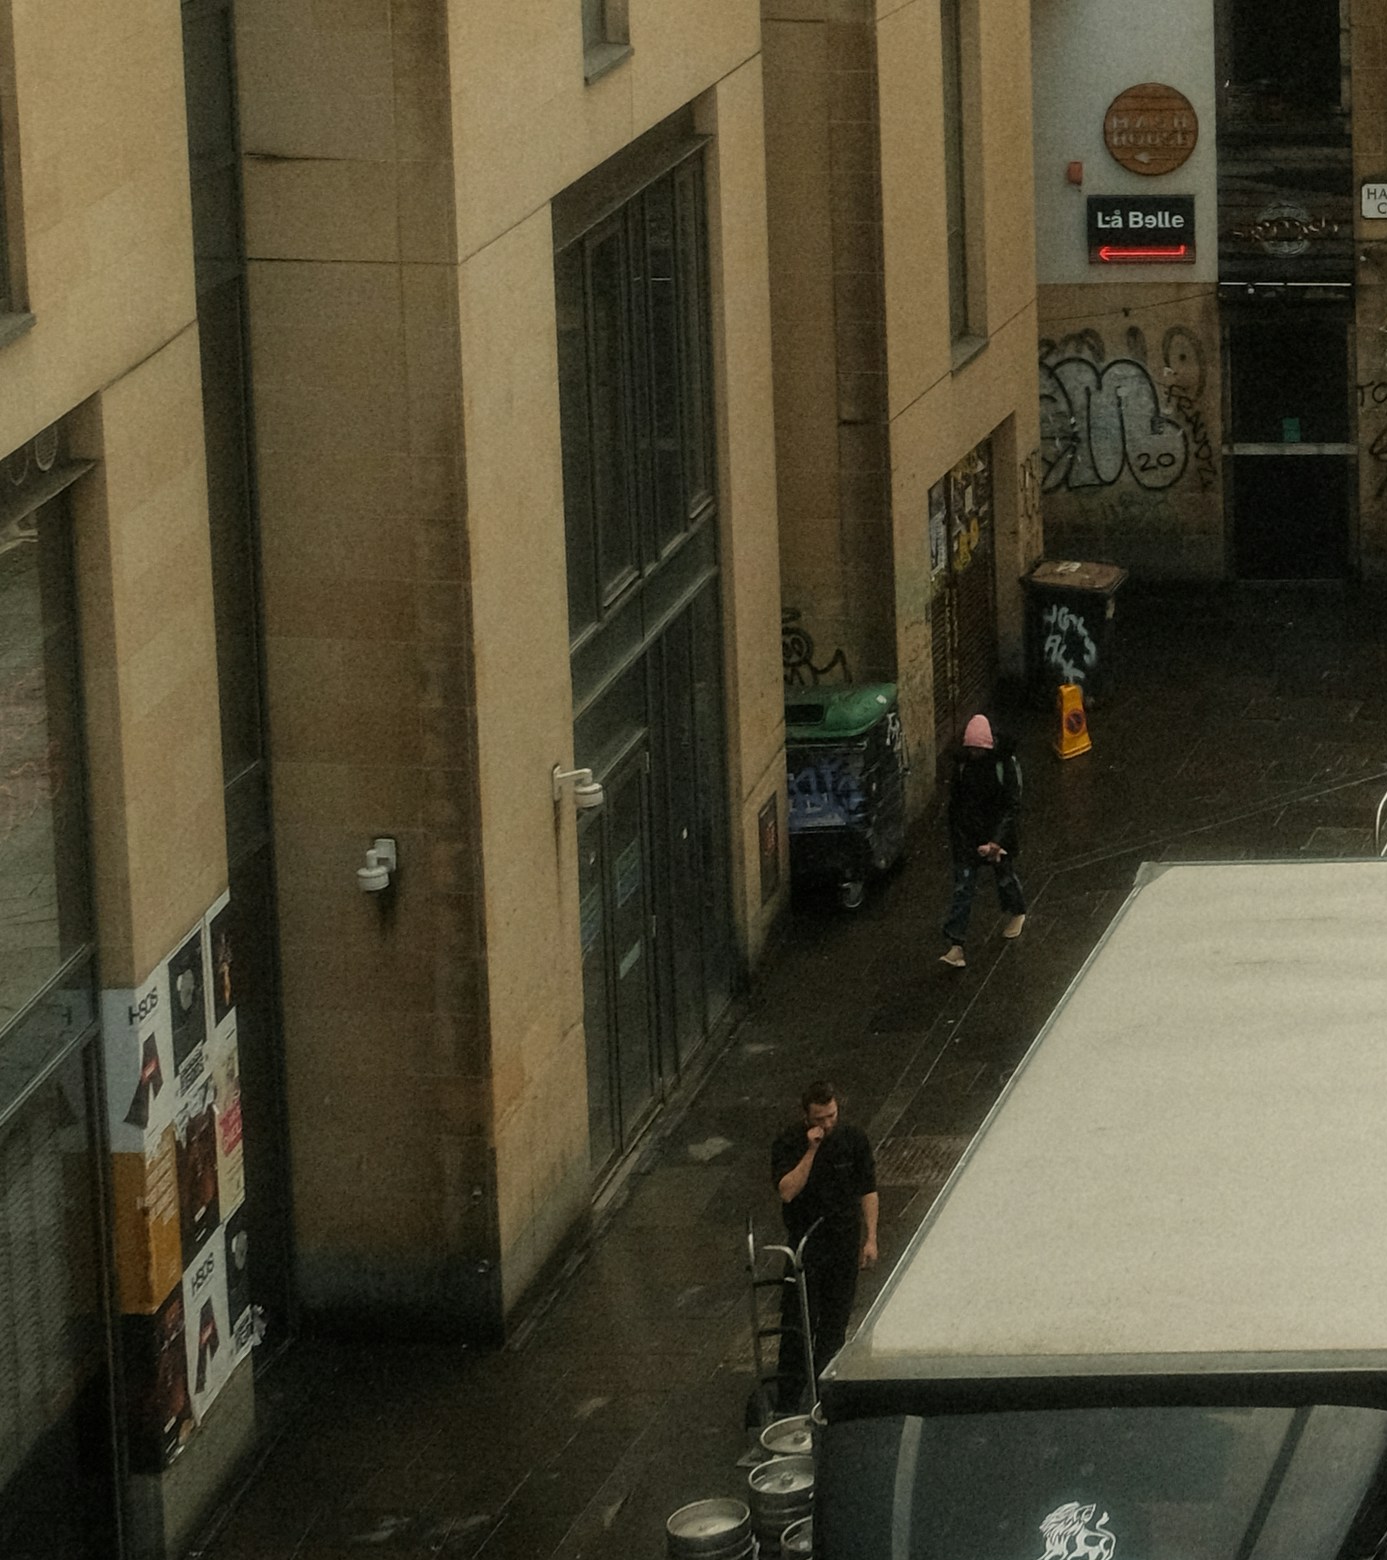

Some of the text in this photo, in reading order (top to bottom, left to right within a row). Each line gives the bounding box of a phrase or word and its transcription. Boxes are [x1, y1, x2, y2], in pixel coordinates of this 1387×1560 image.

[1111, 115, 1188, 130] MASH
[1112, 132, 1188, 148] HOUSE
[1138, 452, 1176, 472] 20
